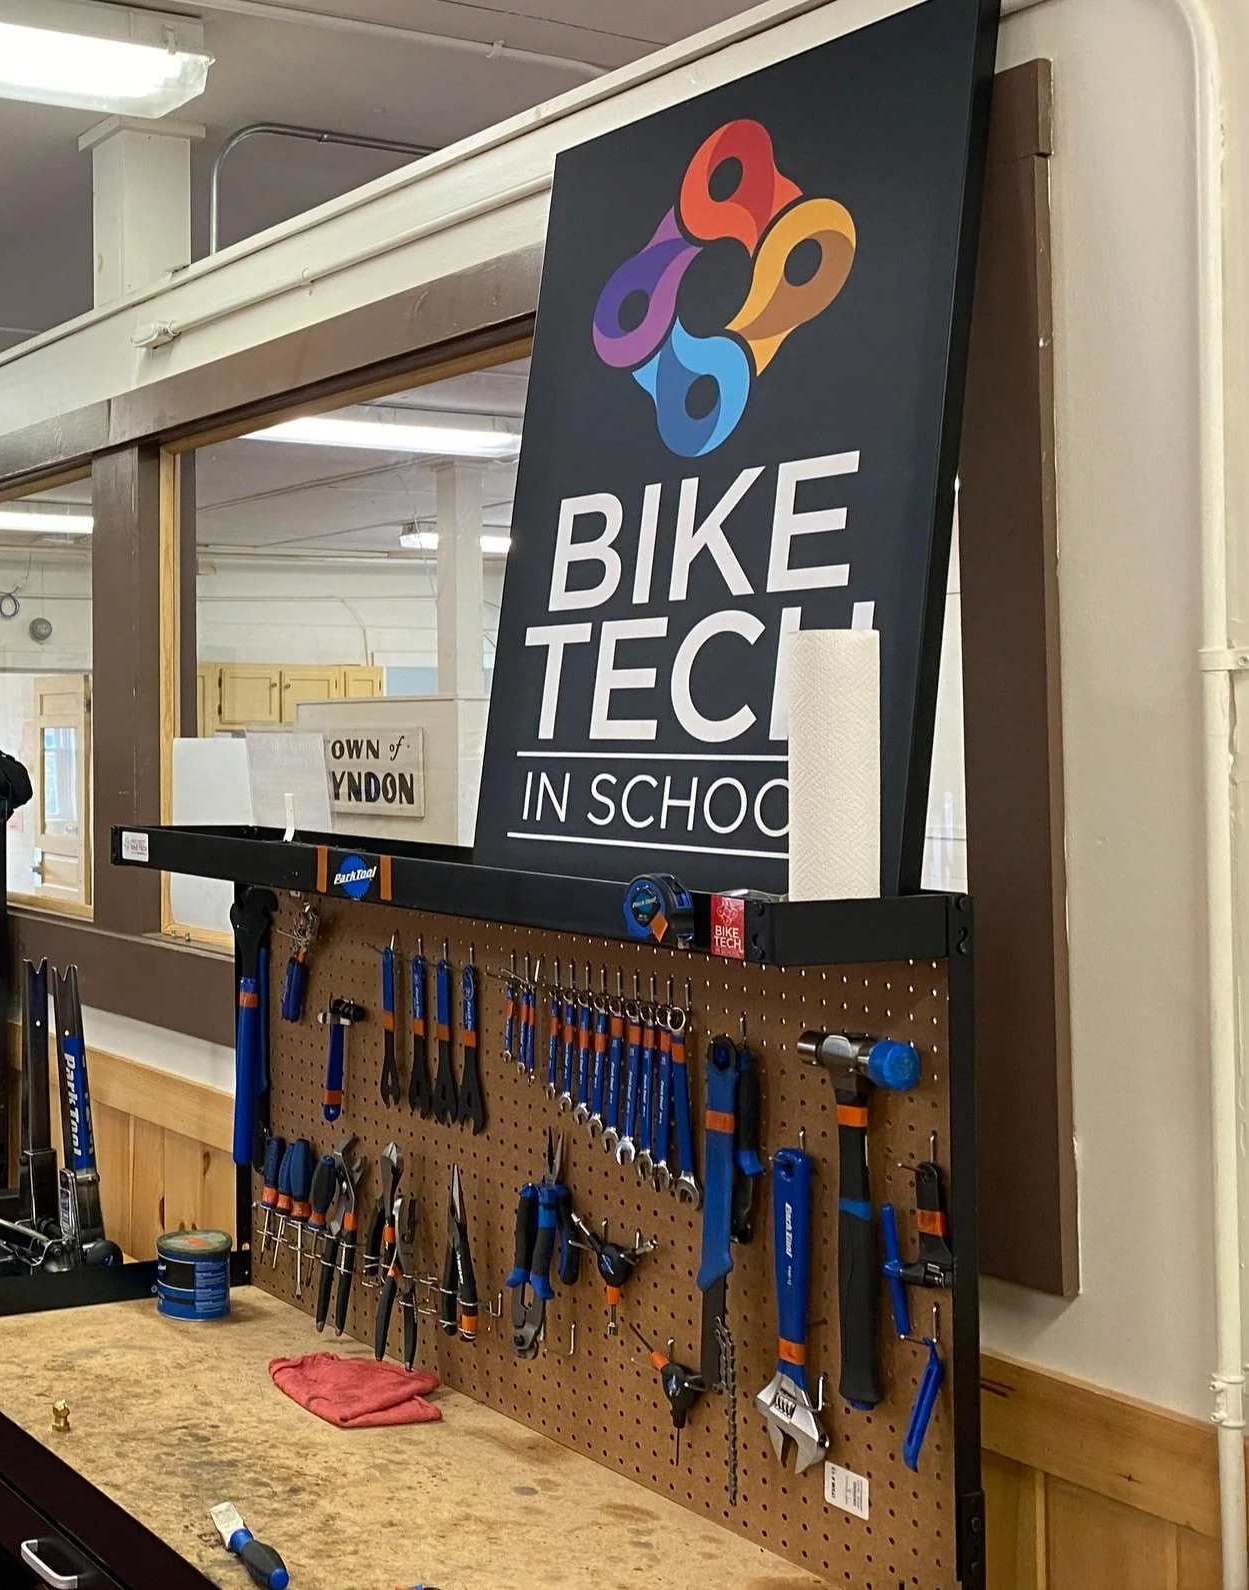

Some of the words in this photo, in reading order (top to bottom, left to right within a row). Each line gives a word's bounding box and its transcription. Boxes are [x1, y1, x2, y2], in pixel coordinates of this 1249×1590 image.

[548, 449, 860, 612] BIKE
[330, 738, 380, 760] OWN
[389, 735, 405, 761] of
[331, 770, 415, 805] YNDON
[521, 771, 571, 823] IN
[586, 772, 790, 838] SCHOO
[713, 935, 742, 950] TECH
[715, 925, 740, 939] BIKE
